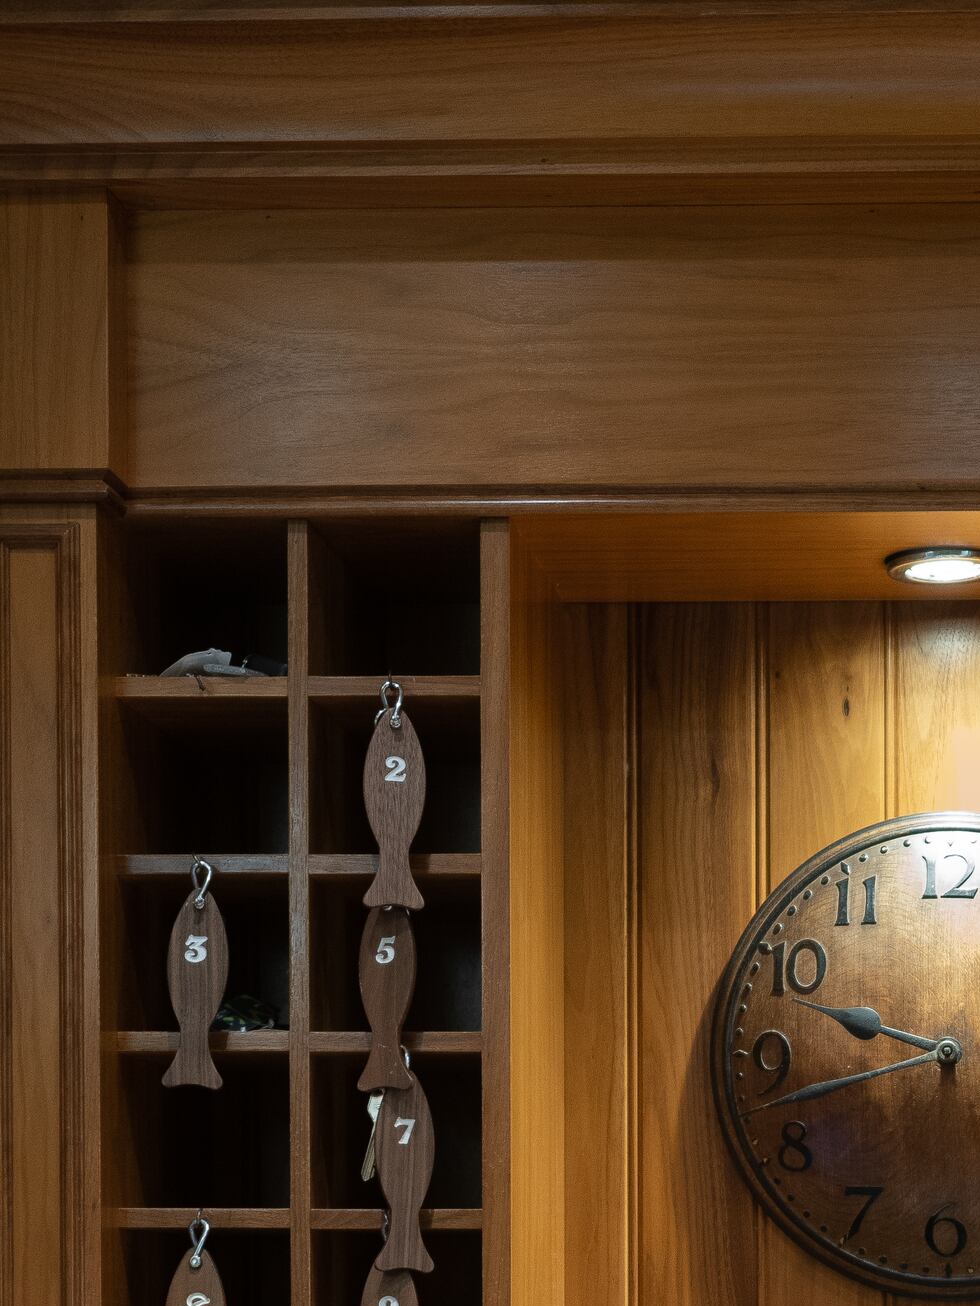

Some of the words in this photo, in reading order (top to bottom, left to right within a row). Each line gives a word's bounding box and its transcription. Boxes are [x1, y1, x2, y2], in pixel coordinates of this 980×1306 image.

[384, 755, 407, 783] 2
[834, 875, 877, 926] 11
[922, 854, 978, 899] 12
[184, 934, 209, 964] 3
[375, 935, 396, 964] 5
[770, 938, 827, 996] 10
[752, 1030, 791, 1096] 9
[393, 1116, 416, 1145] 7
[778, 1121, 813, 1172] 8
[844, 1186, 884, 1241] 7
[924, 1203, 967, 1257] 6
